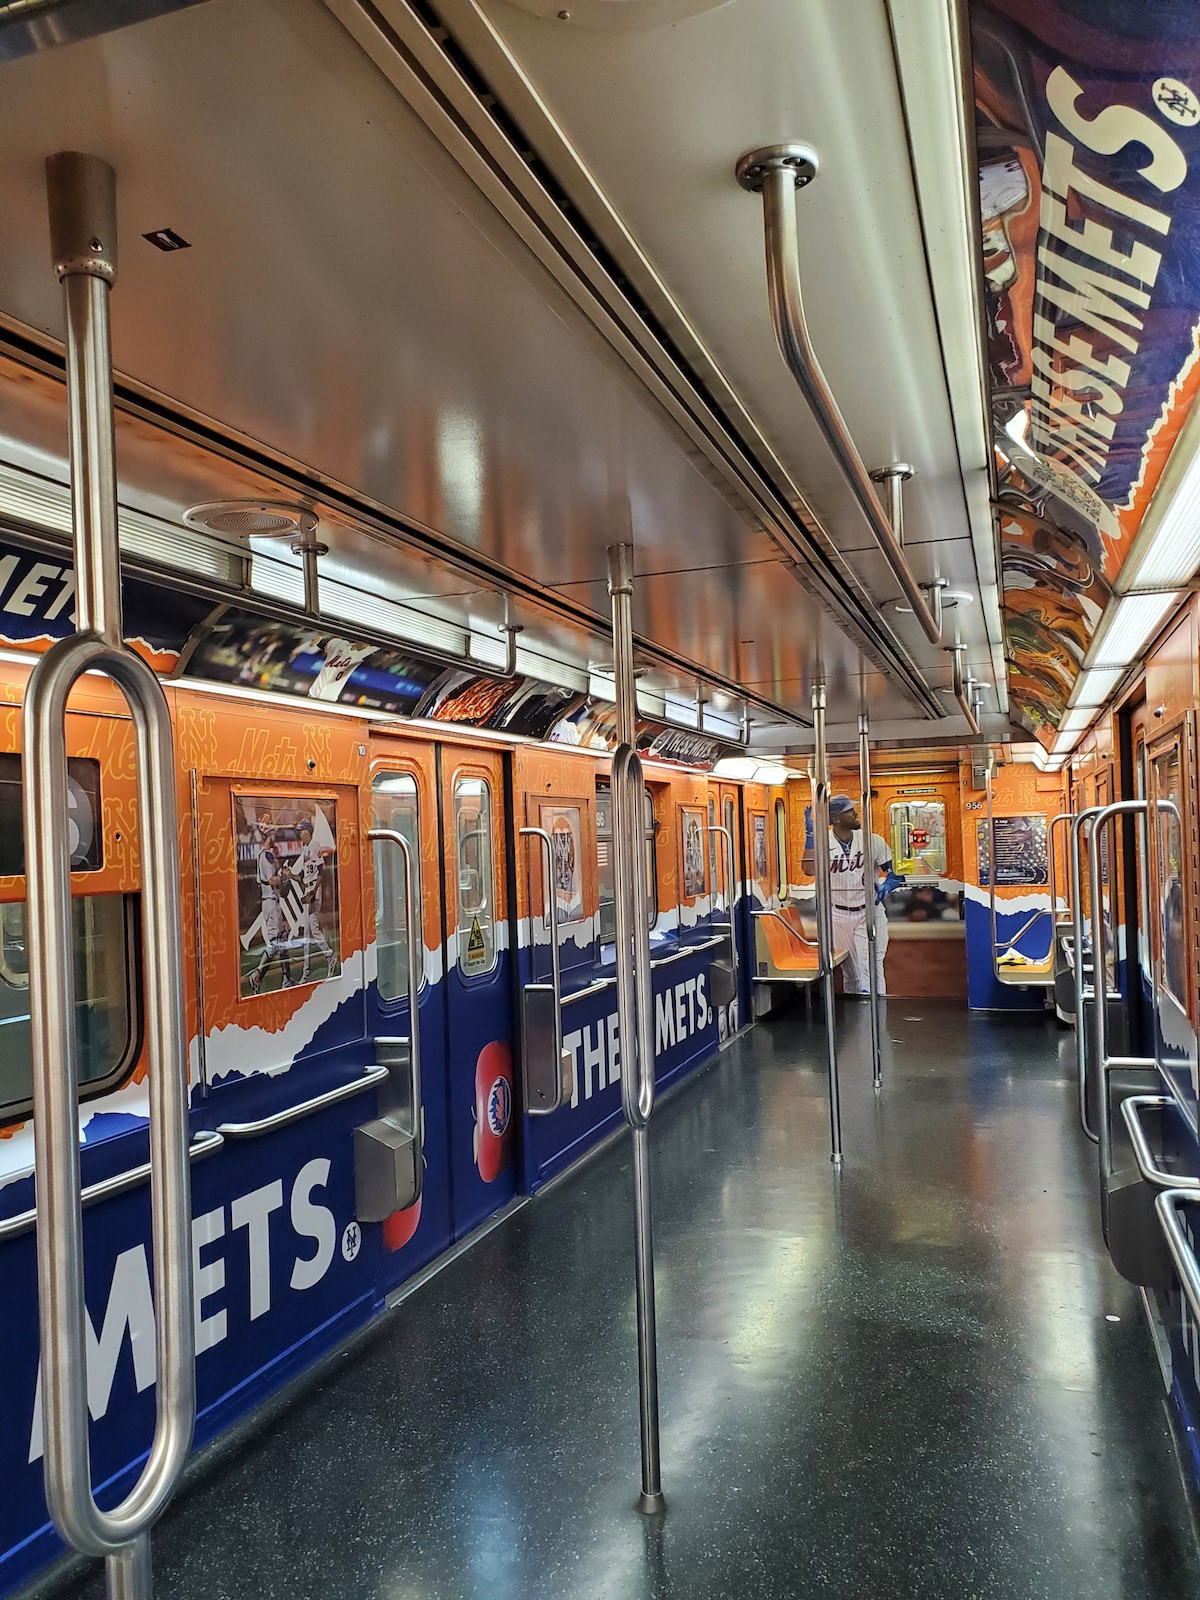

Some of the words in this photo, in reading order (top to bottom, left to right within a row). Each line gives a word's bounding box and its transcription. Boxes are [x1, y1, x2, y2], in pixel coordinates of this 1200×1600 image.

[1036, 65, 1188, 355] METS
[1031, 307, 1132, 483] THESE
[0, 554, 77, 625] ET
[325, 654, 352, 668] Mets
[335, 671, 344, 682] 0
[965, 801, 983, 810] 956
[830, 850, 864, 874] Met
[561, 1010, 621, 1110] THE
[655, 972, 708, 1057] METS
[28, 1157, 337, 1465] METS
